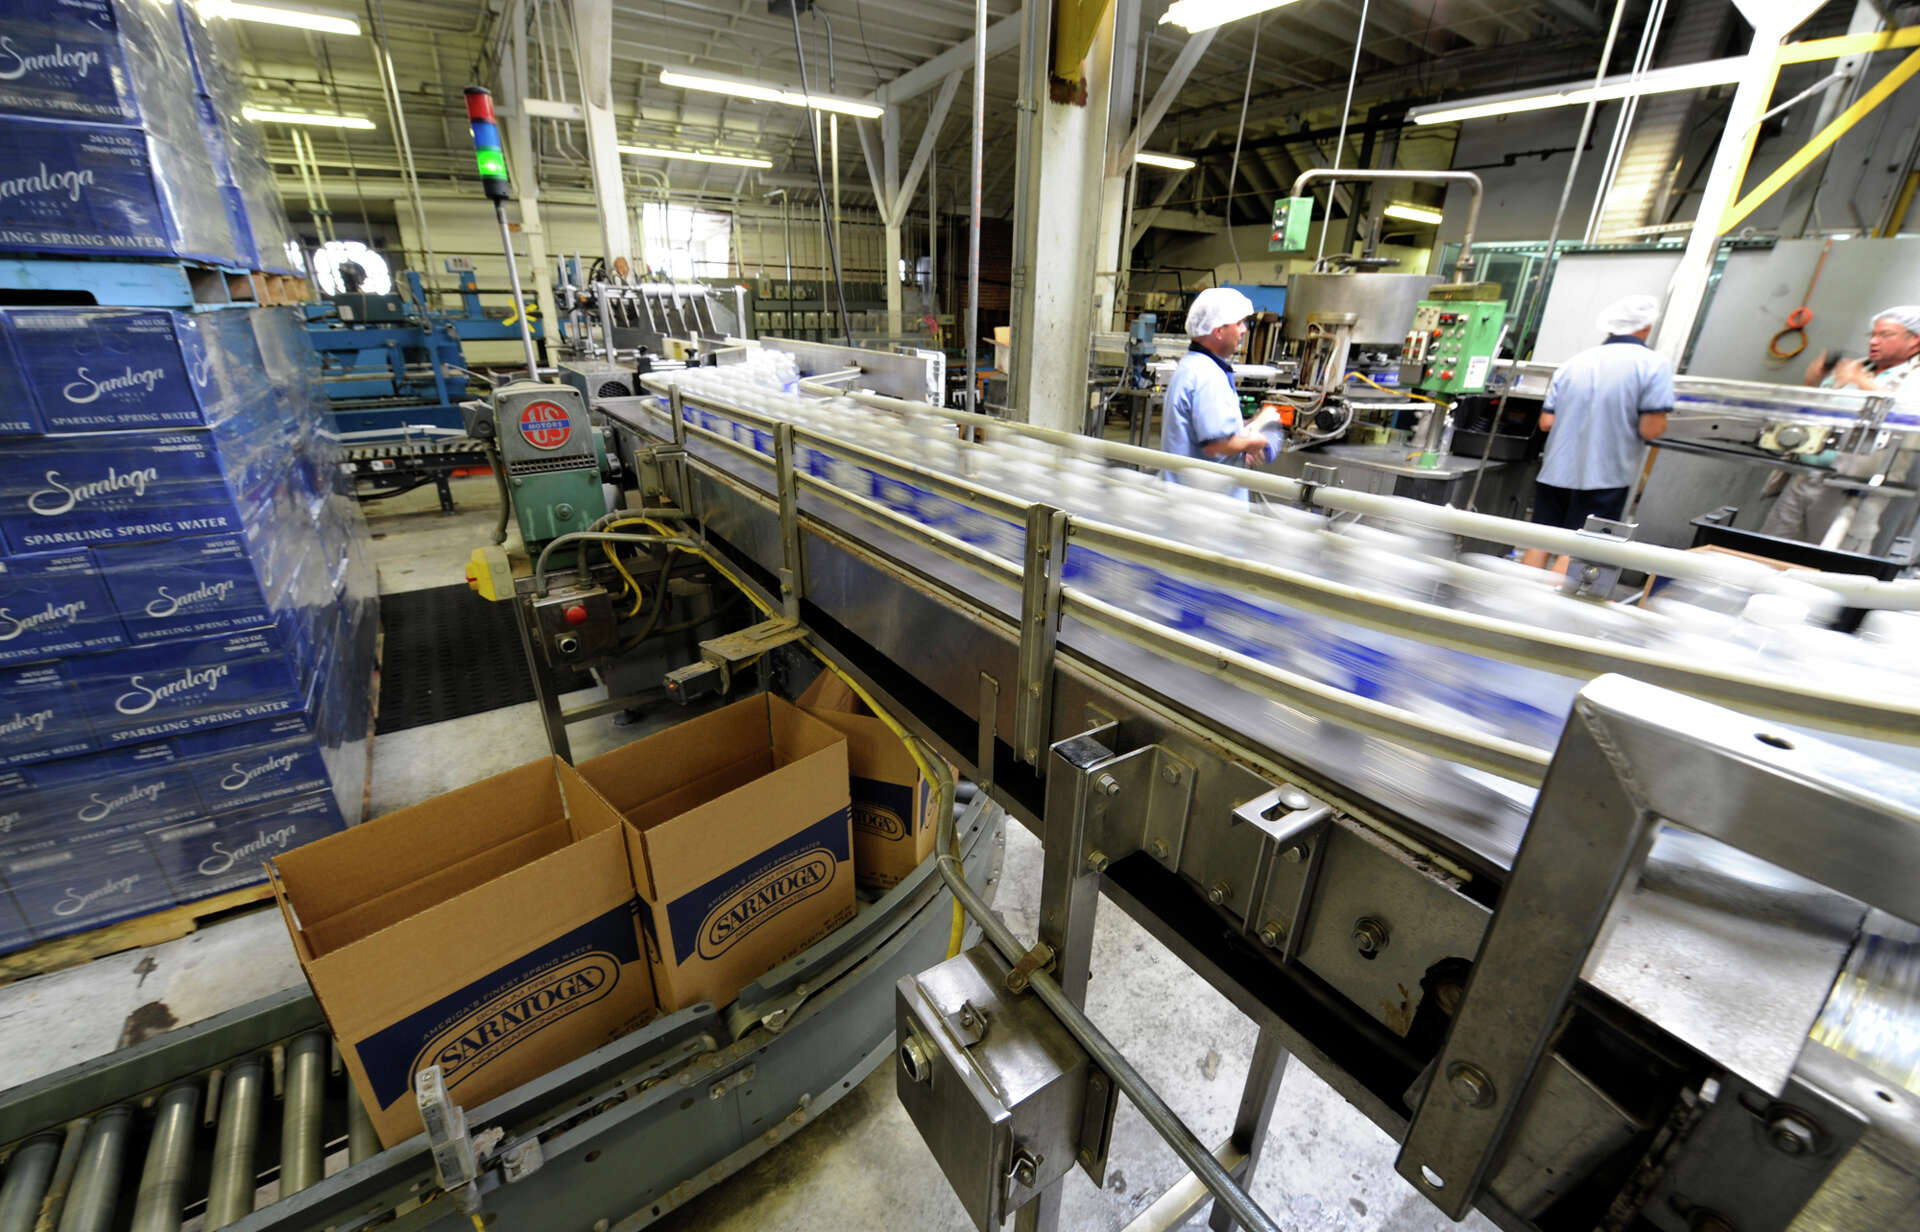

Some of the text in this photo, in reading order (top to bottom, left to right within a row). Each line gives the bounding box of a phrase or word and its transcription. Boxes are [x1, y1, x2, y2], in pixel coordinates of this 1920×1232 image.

[0, 162, 95, 202] aratoga
[40, 232, 105, 247] SPRING
[110, 235, 167, 249] WATER
[63, 366, 165, 403] Saratoga
[51, 411, 199, 426] SPARKLING SPRING WATER
[528, 421, 563, 430] MOTORS
[28, 466, 158, 516] Saratoga
[24, 517, 228, 546] SPARKLING SPRING WATER
[146, 580, 234, 618] Saratoga
[40, 641, 83, 652] SPRING
[83, 635, 122, 647] WATER
[136, 614, 265, 639] SPARKLING SPRING WATER
[115, 664, 228, 715] Saratoga
[111, 701, 290, 742] SPARKLING SPRING WATER
[198, 825, 296, 875] Saratoga
[716, 866, 820, 940] SARATOGA
[423, 944, 593, 1041] AMERICA'S FINEST SPRING WATER
[441, 972, 597, 1074] SARATOGA
